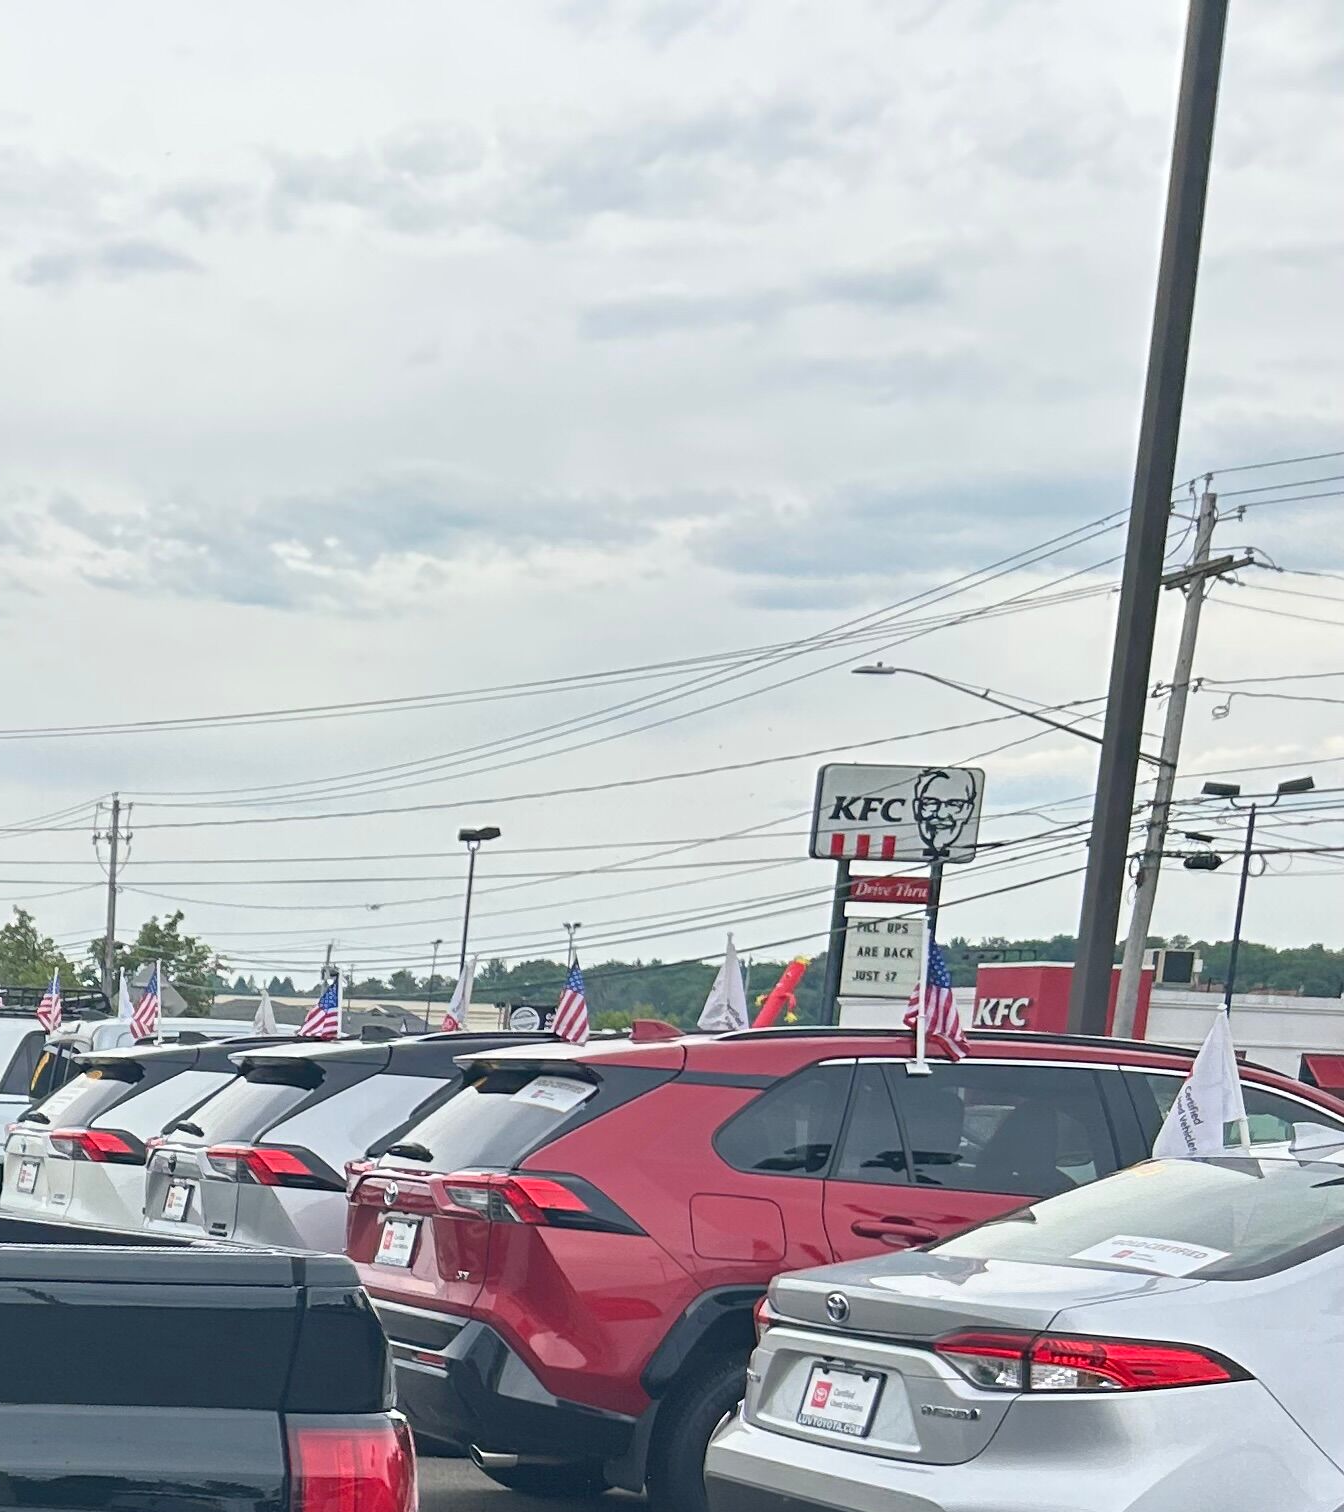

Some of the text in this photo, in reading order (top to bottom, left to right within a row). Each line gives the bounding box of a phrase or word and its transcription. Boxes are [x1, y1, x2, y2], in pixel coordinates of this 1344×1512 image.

[829, 795, 906, 822] KFC
[855, 882, 928, 898] Drive Thru
[887, 923, 909, 934] UPS
[856, 947, 914, 959] ARE BACK
[852, 970, 880, 981] JUST
[973, 998, 1031, 1027] KFC
[1185, 1085, 1204, 1126] Certified
